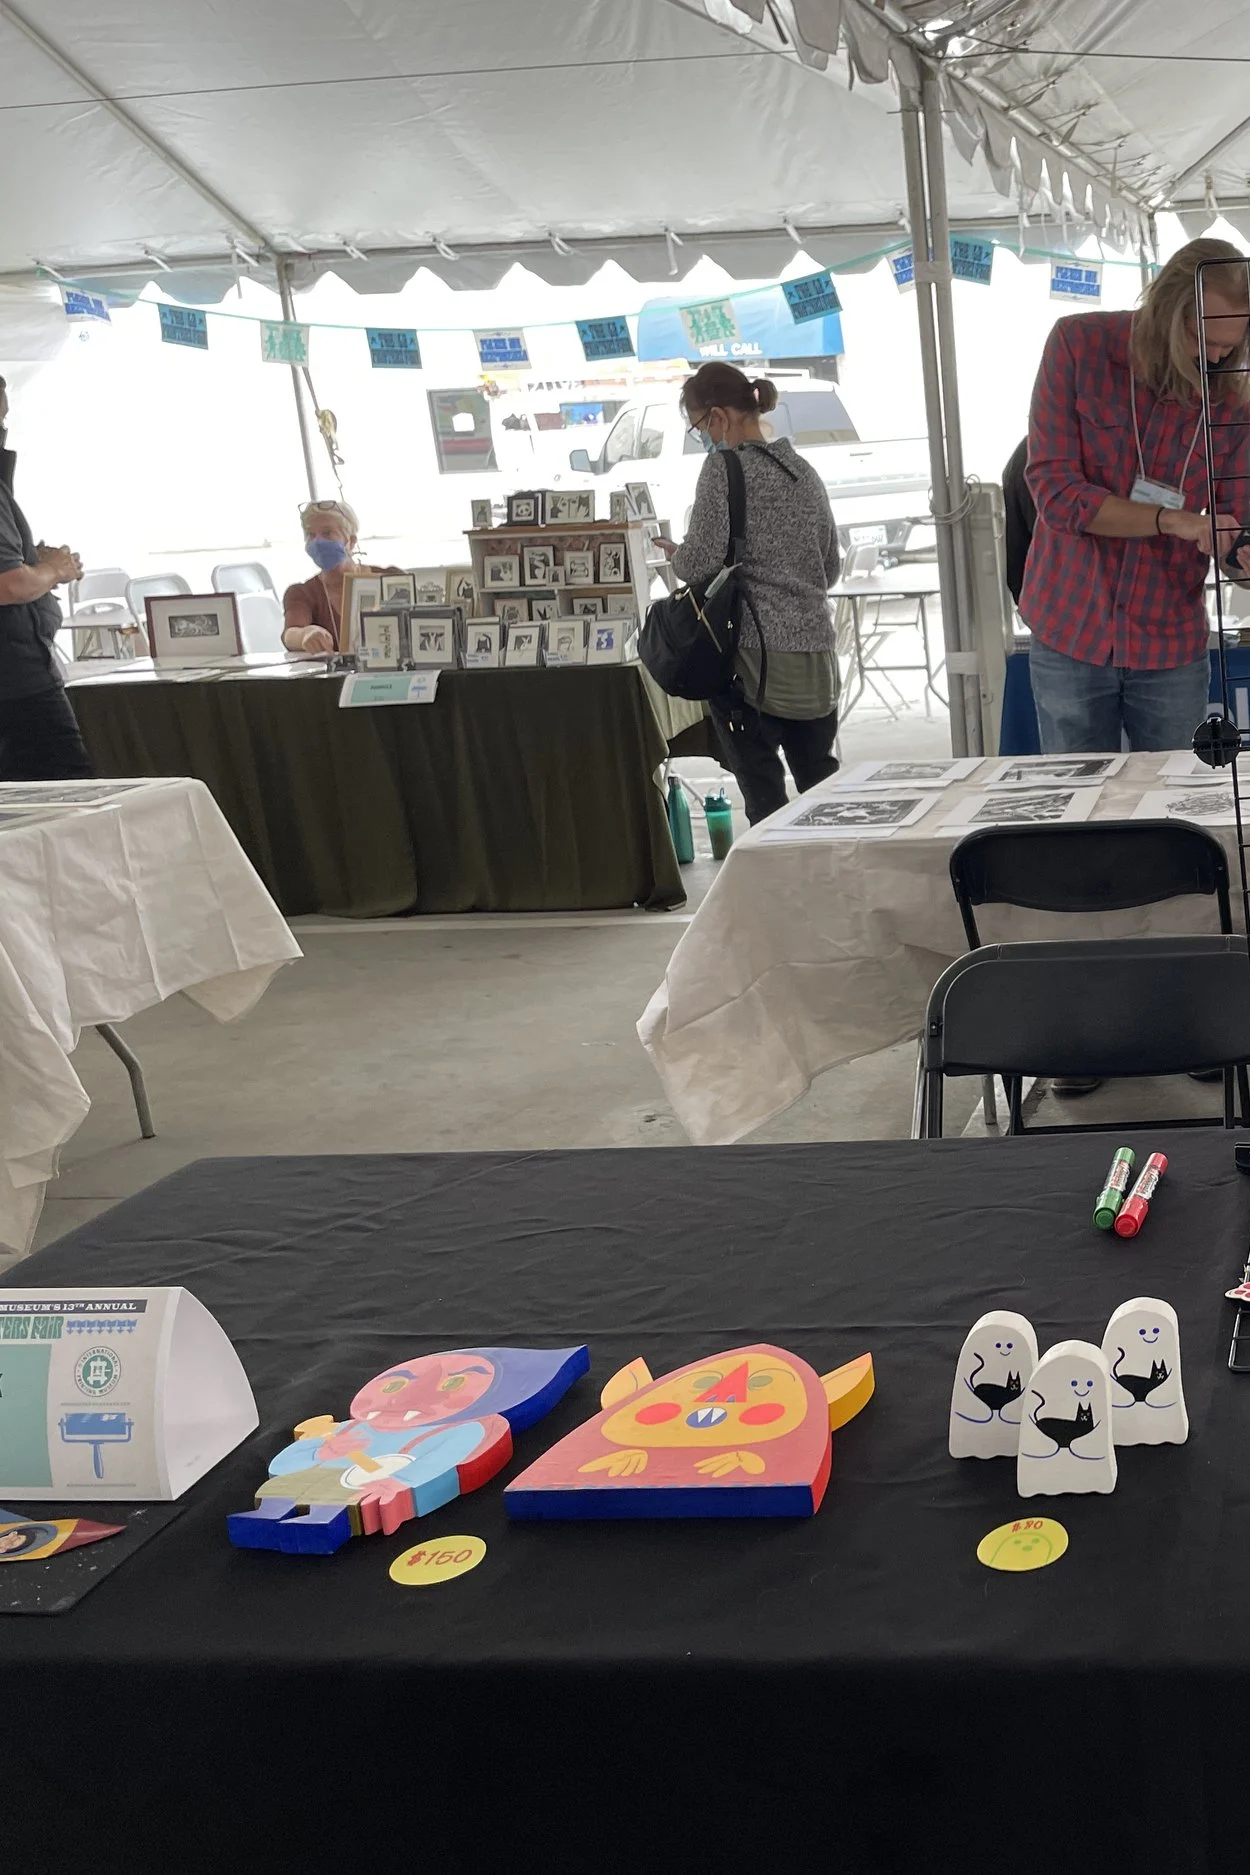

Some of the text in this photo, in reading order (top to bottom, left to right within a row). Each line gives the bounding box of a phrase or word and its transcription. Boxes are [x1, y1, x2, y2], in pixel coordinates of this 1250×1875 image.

[731, 342, 763, 355] CALL
[85, 1302, 137, 1311] ANNUAL
[406, 1549, 473, 1567] $150
